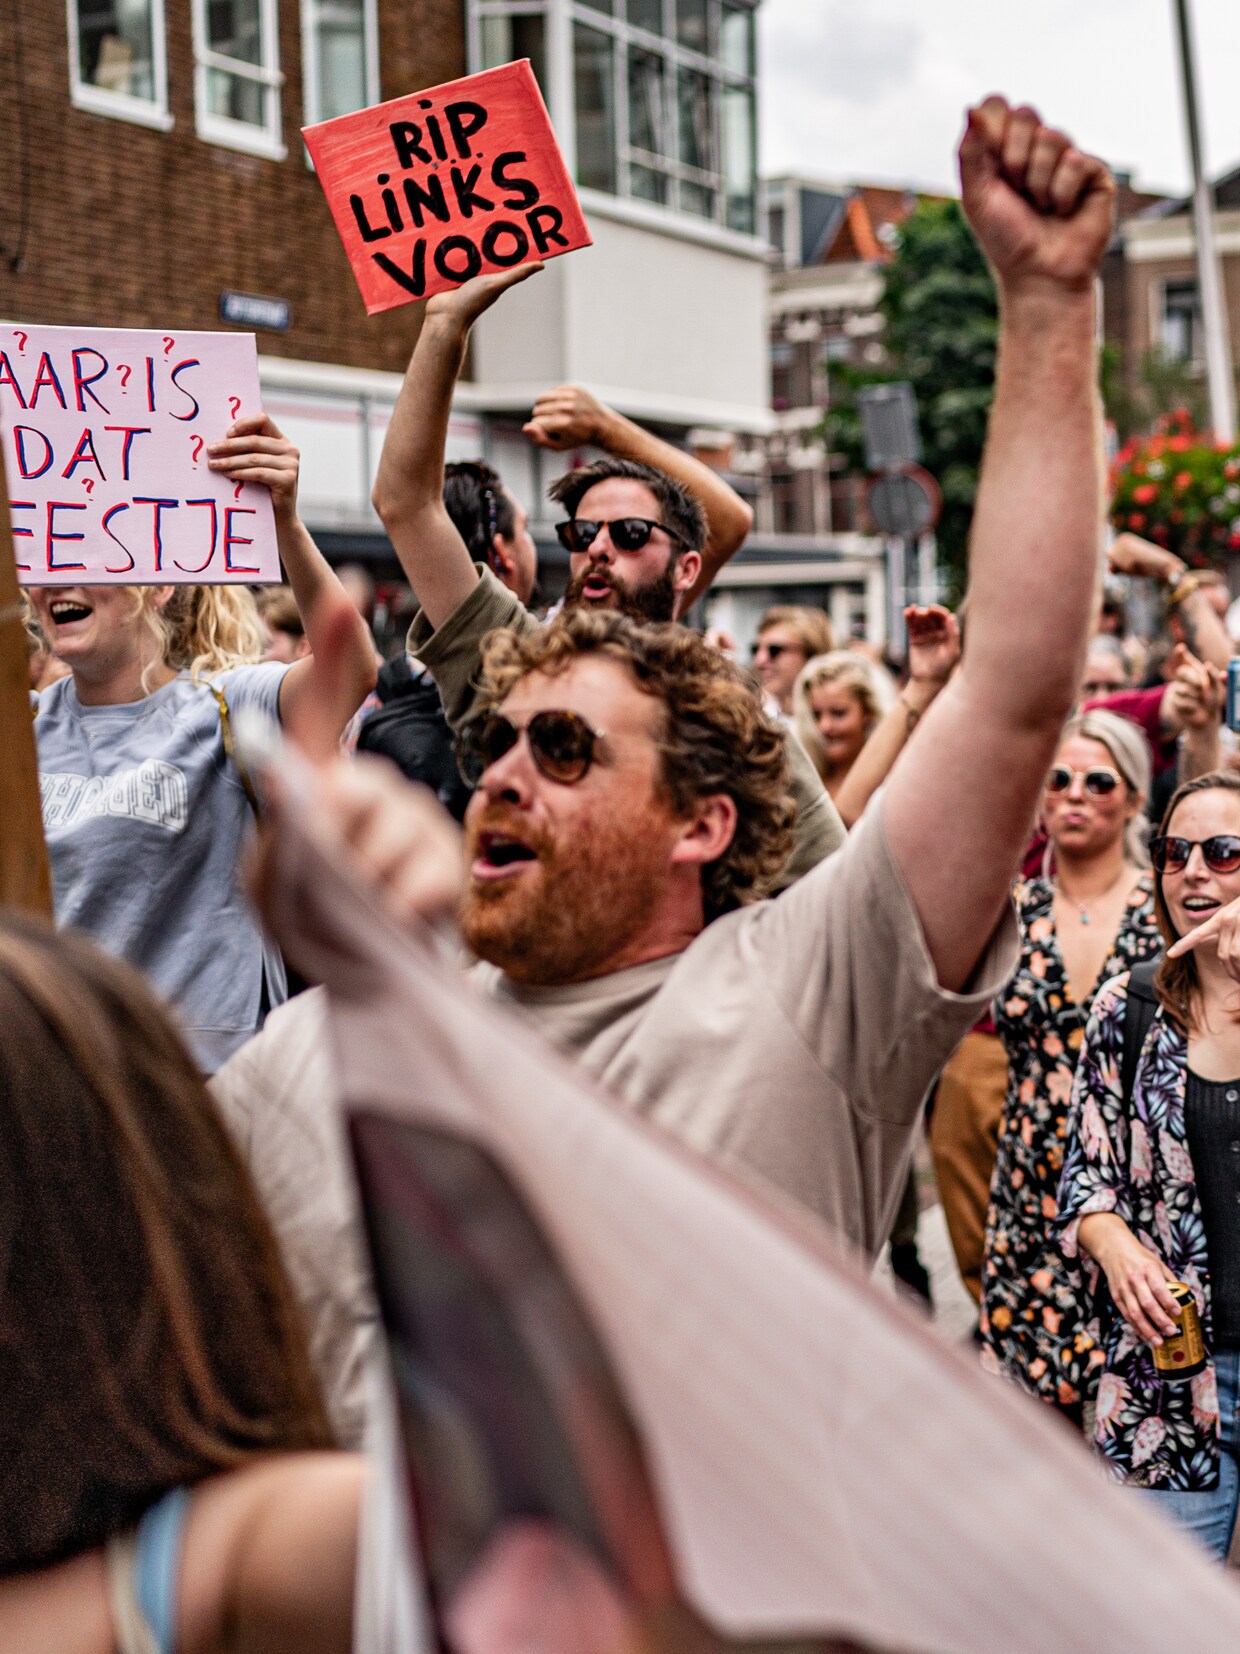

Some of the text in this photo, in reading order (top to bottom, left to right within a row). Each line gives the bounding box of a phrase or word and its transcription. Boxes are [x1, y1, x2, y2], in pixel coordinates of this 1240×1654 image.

[371, 204, 570, 297] VOOR
[145, 356, 201, 422] IS
[13, 424, 152, 481] DAT
